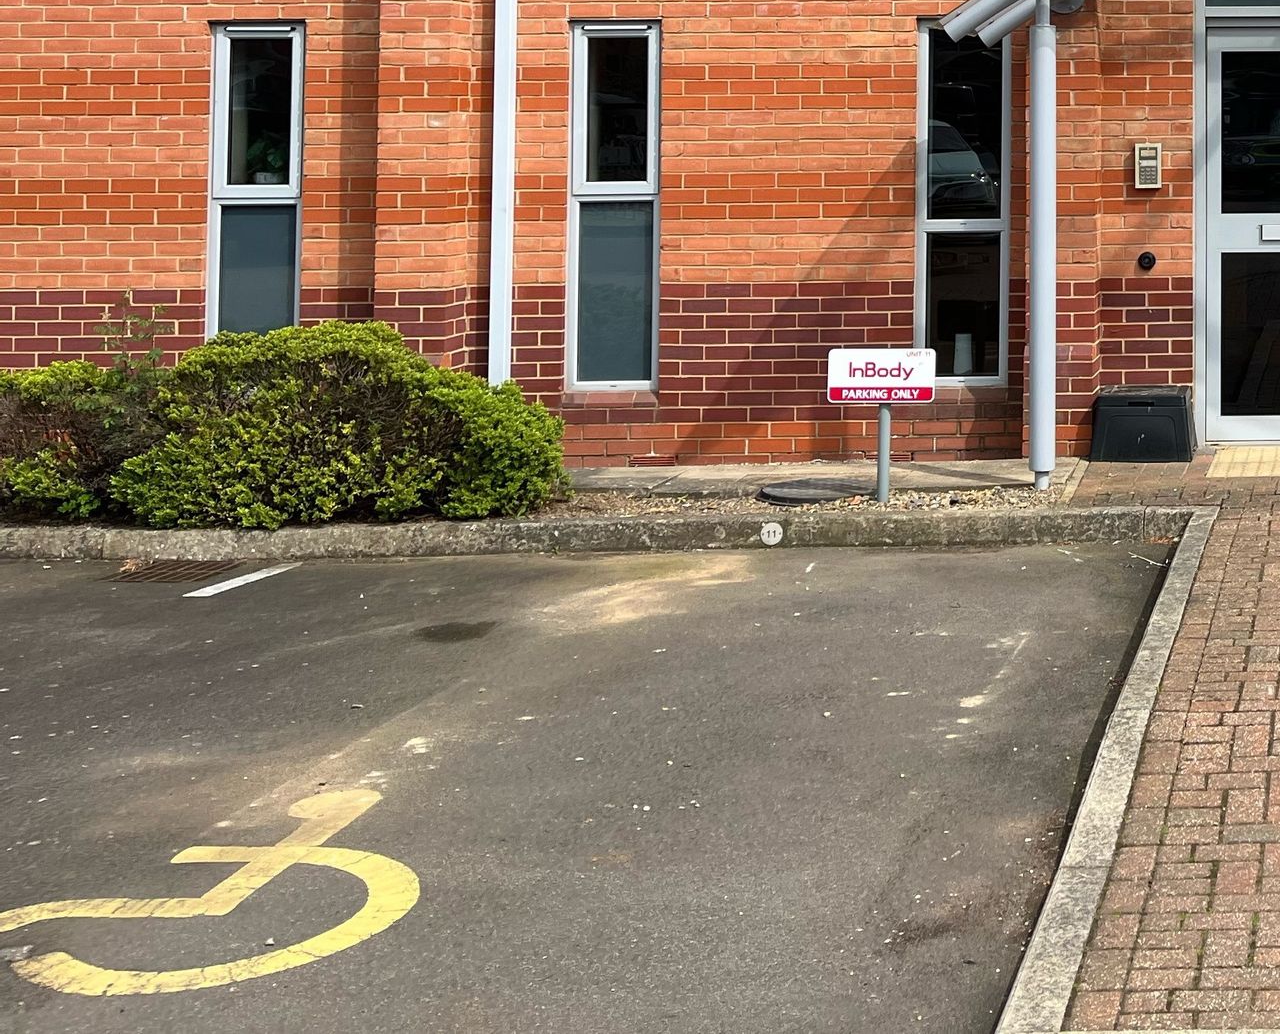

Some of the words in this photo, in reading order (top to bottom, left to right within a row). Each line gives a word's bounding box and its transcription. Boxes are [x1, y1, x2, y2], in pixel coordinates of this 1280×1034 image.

[849, 361, 914, 381] InBody
[841, 389, 888, 399] PARKING
[890, 389, 920, 399] ONLY
[766, 529, 776, 538] 11
